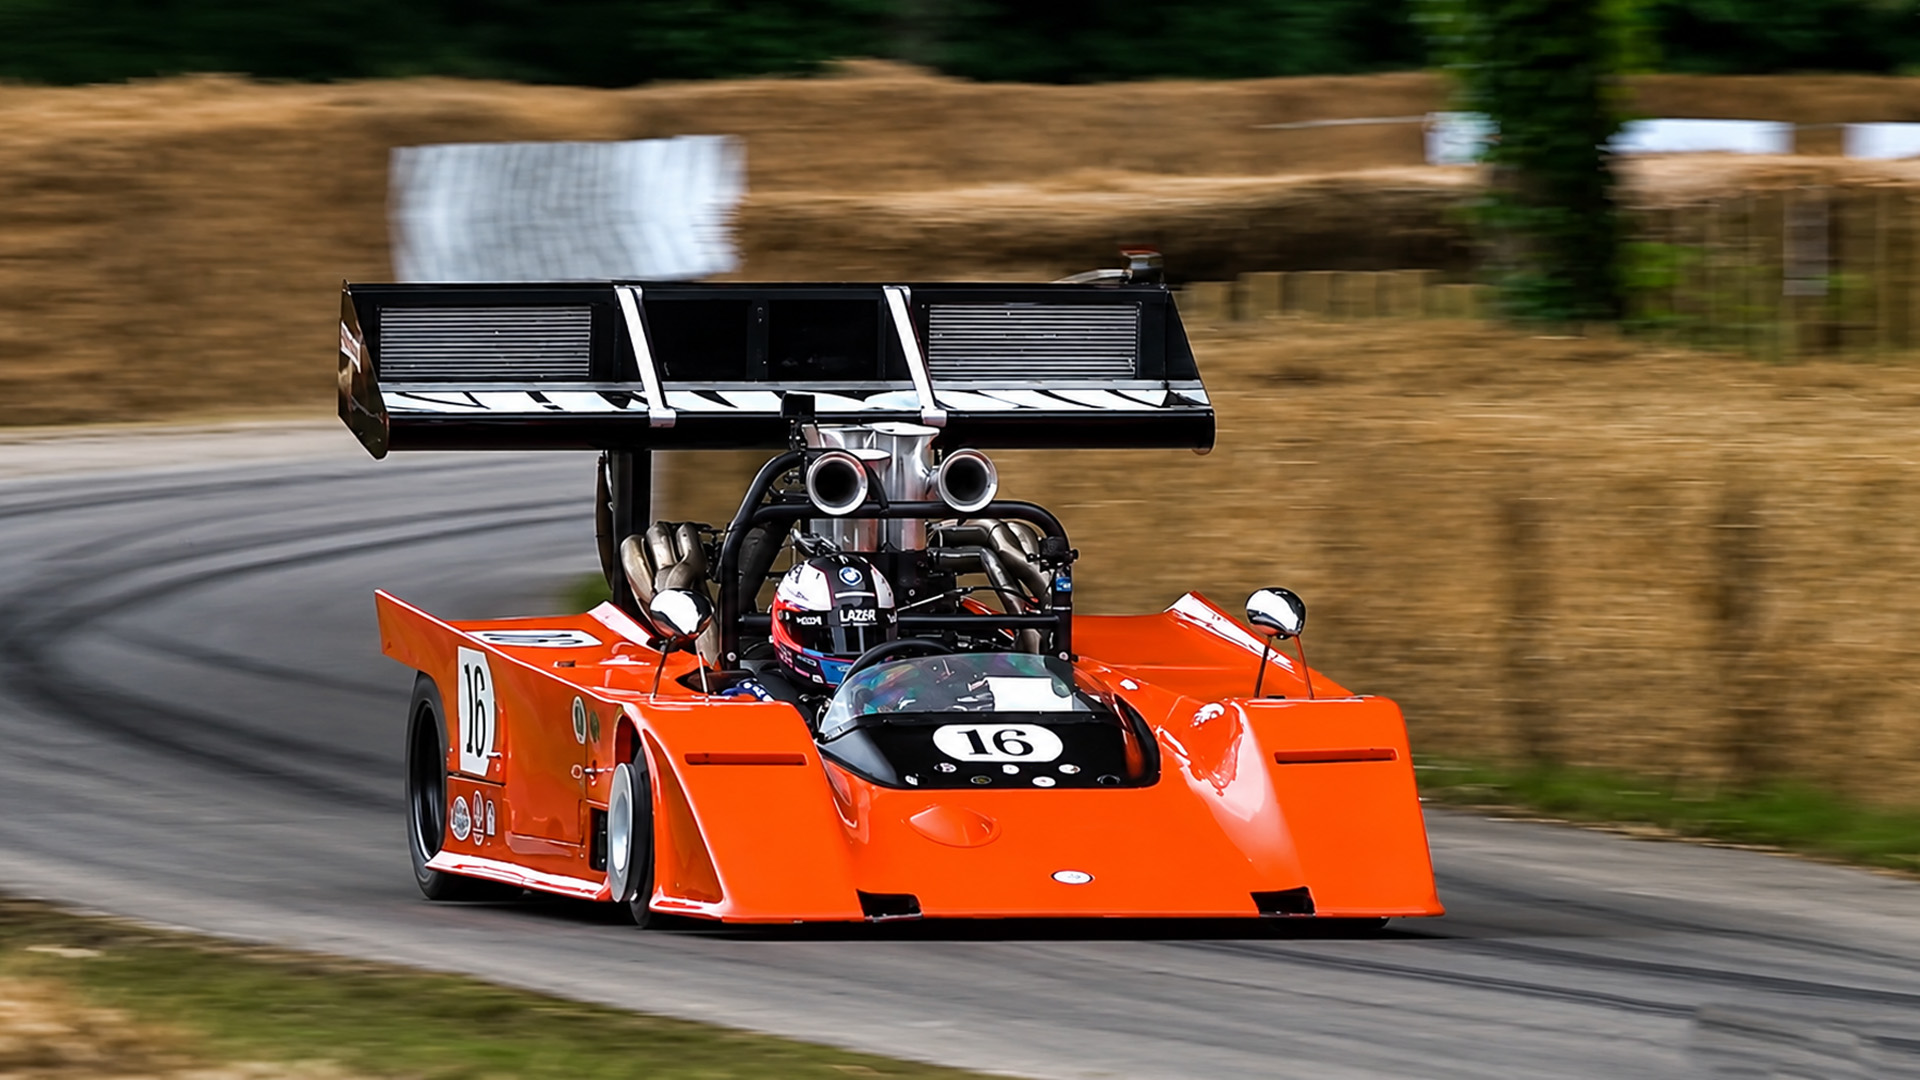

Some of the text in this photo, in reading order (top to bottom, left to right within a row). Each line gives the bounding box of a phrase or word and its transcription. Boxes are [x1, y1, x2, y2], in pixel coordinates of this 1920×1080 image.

[839, 608, 876, 622] LAZER
[464, 664, 486, 758] 16
[956, 728, 1035, 757] 16
